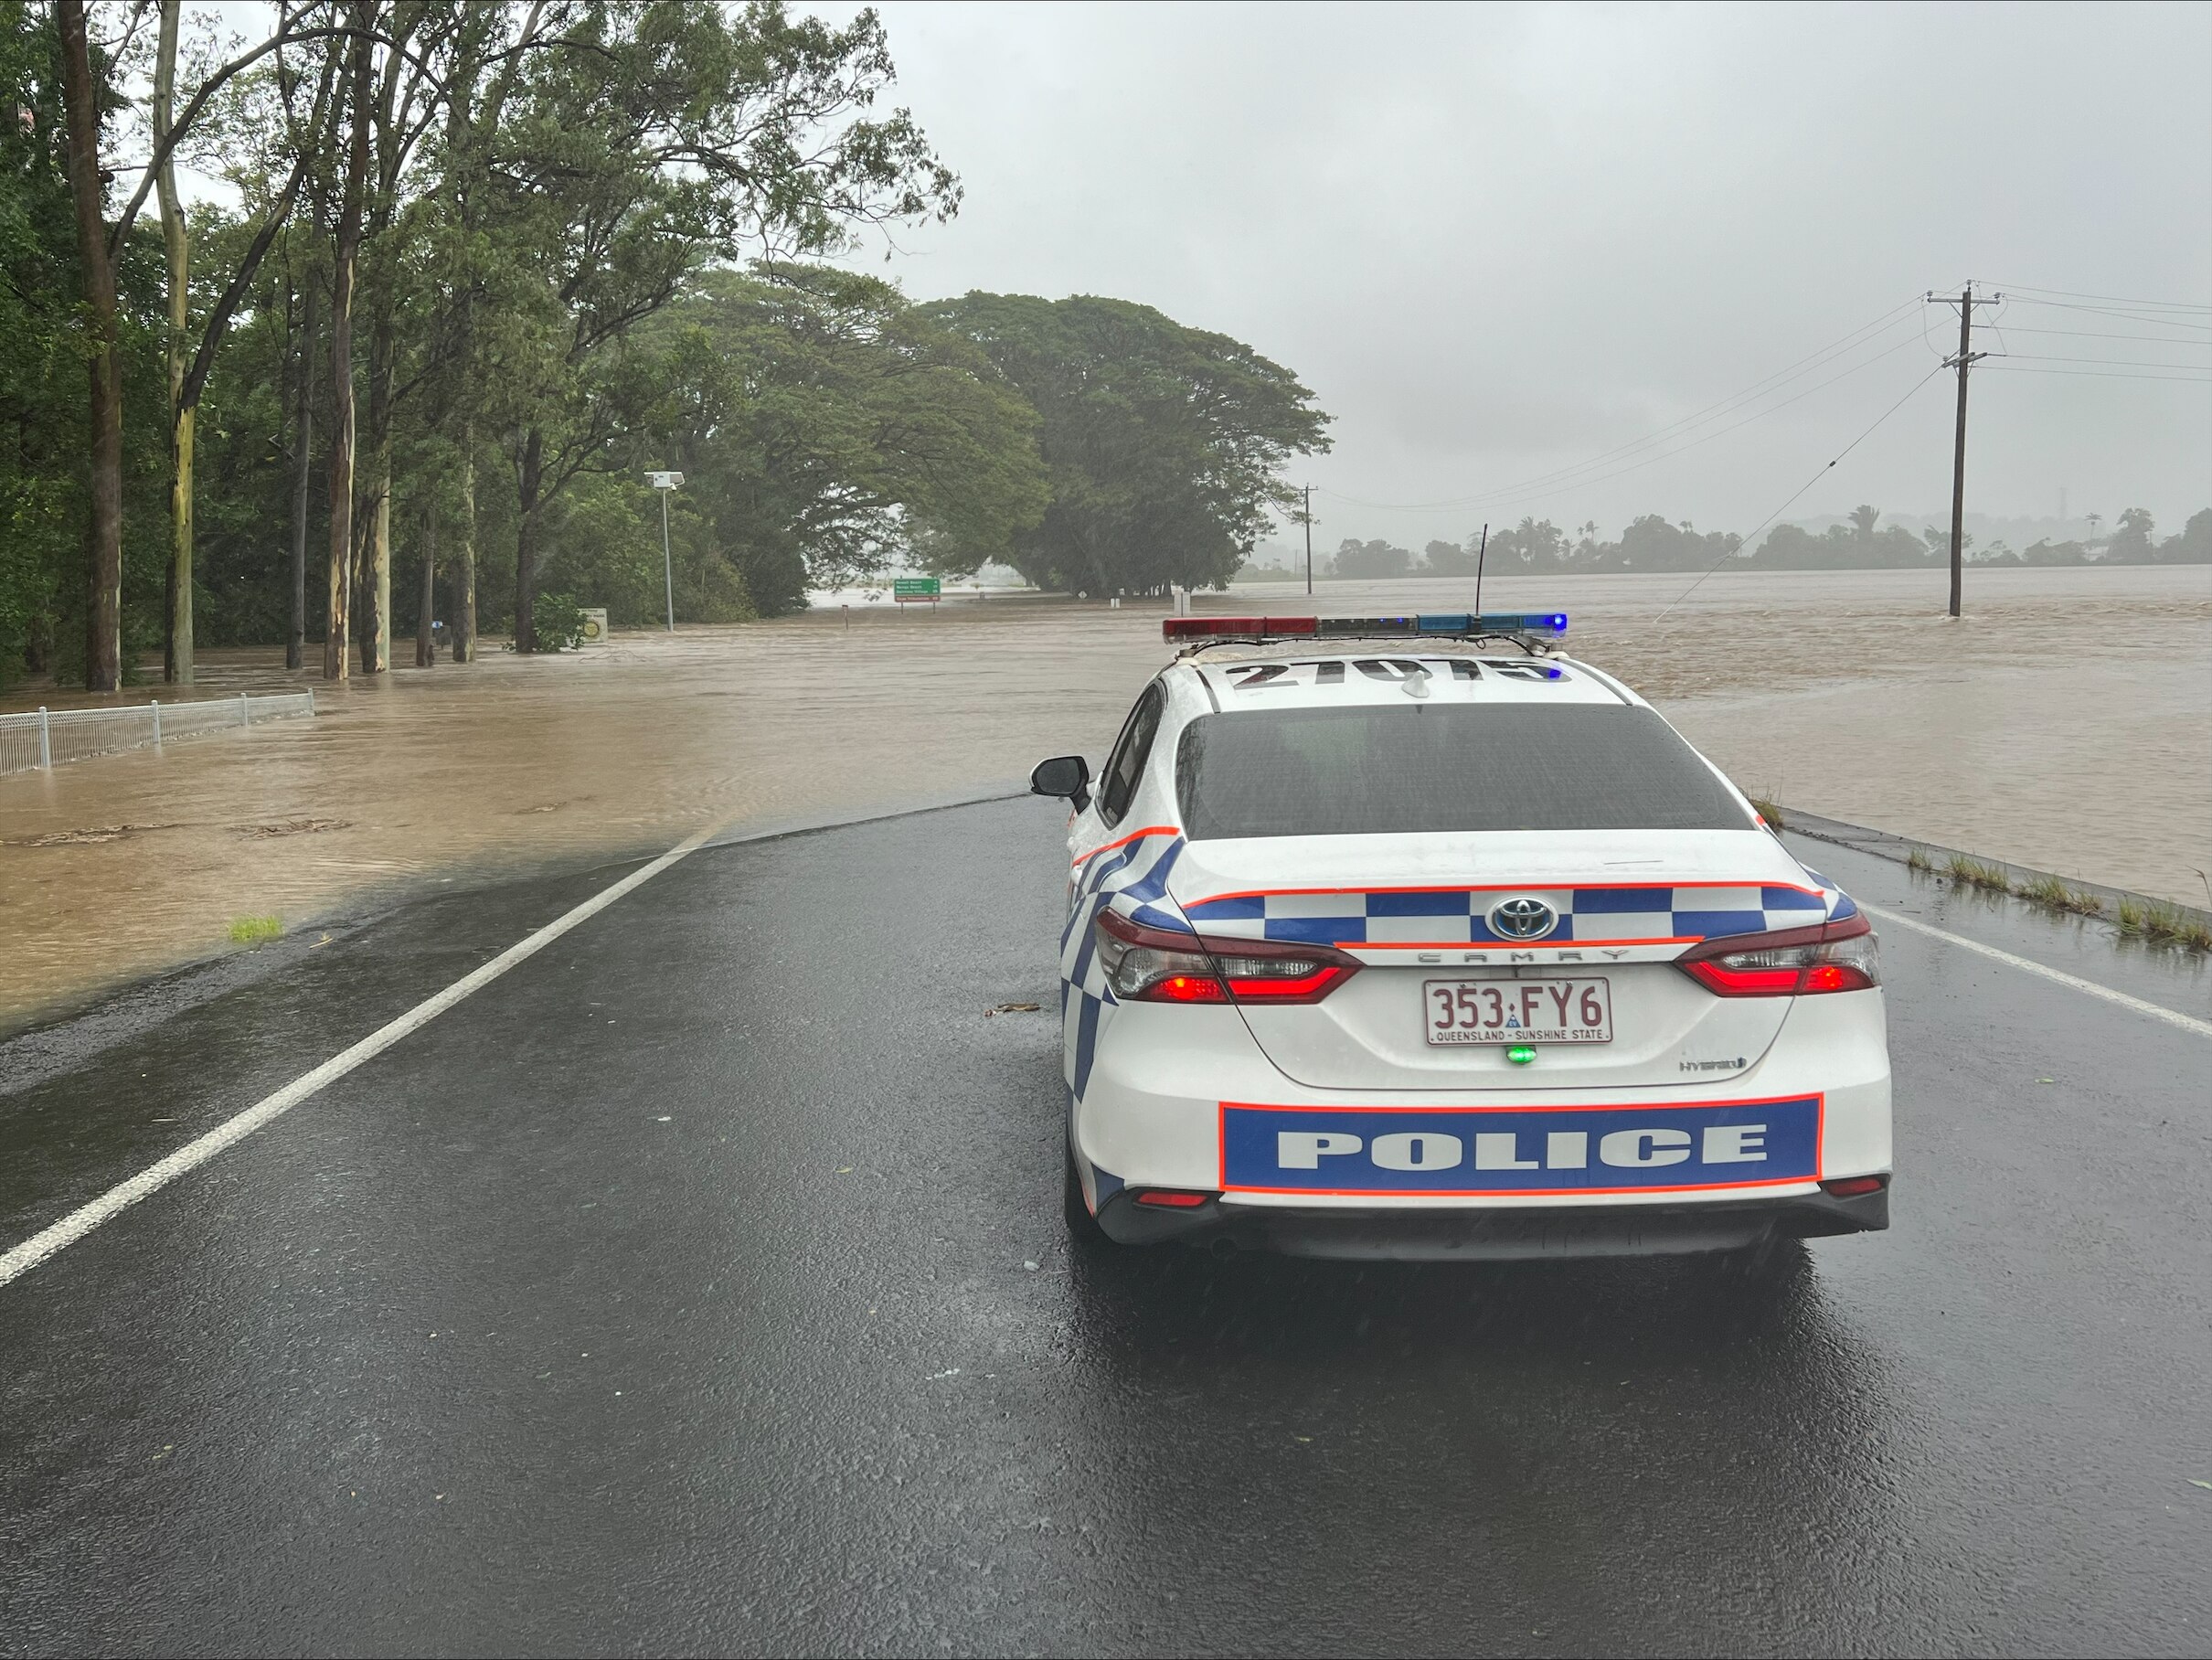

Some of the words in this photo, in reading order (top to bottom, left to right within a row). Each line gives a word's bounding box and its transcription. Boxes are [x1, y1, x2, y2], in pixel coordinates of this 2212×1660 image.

[1418, 950, 1630, 963] CAMRY
[1436, 1030, 1505, 1041] QUEENSLAND
[1515, 1029, 1567, 1040] SUNSHINE
[1572, 1028, 1603, 1039] STATE
[1278, 1123, 1768, 1171] POLICE
